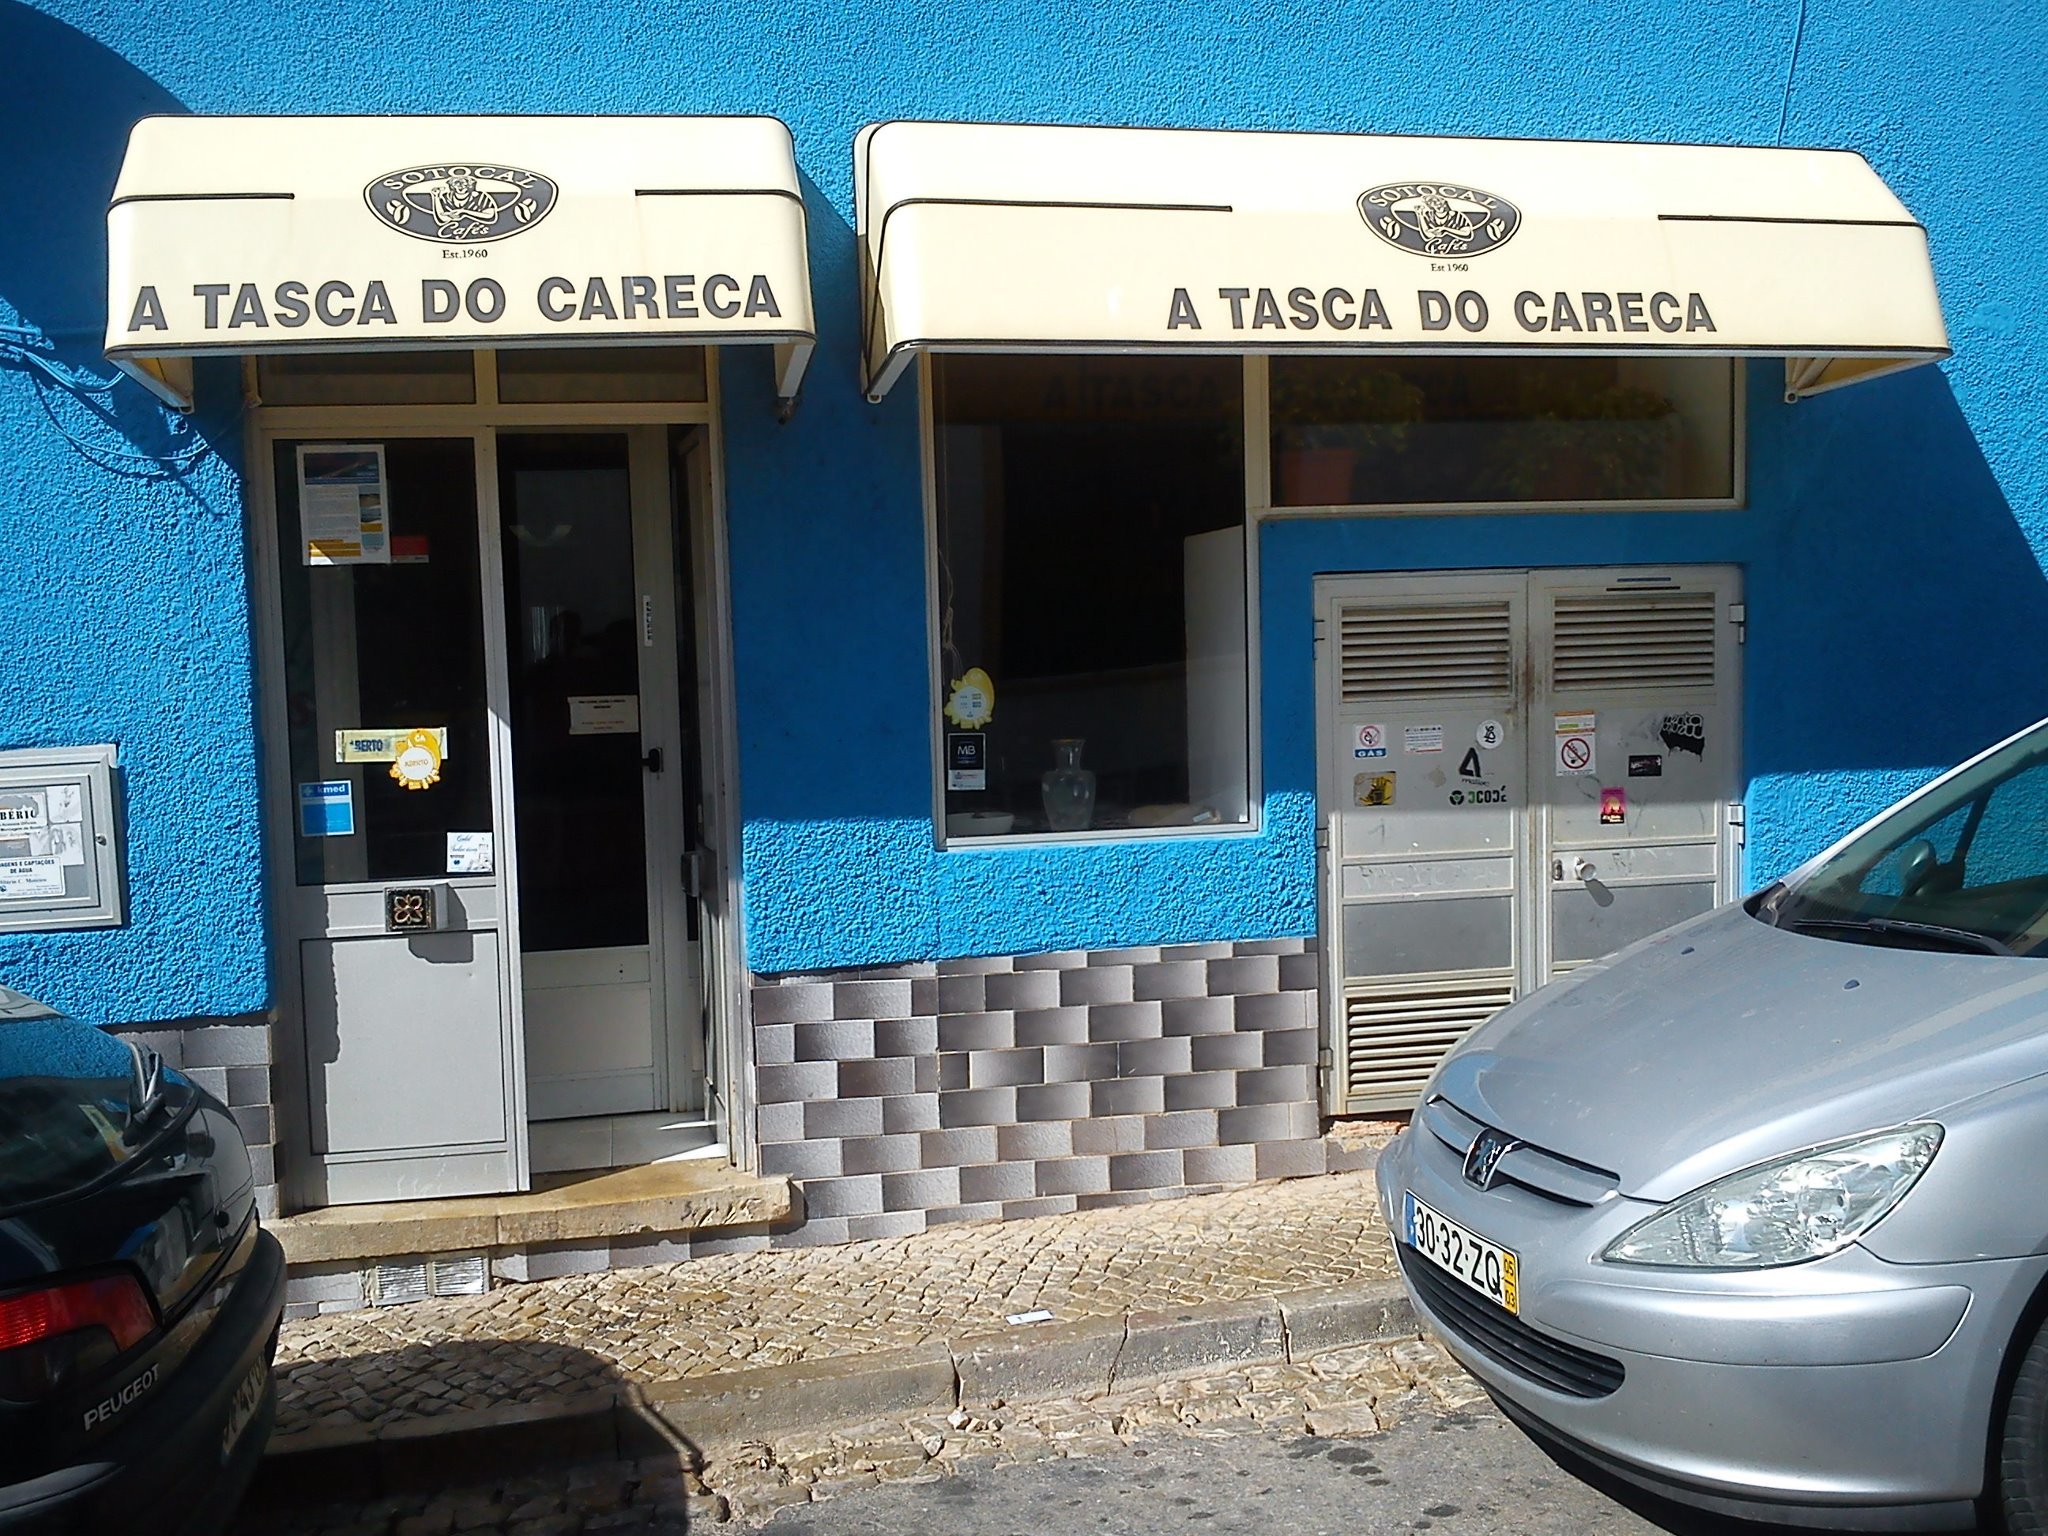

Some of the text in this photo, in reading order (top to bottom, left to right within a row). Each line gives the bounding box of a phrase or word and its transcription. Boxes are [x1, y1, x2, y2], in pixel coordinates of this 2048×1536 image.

[383, 166, 537, 190] SOTOCAL
[1369, 185, 1497, 209] SOTOCAL
[437, 221, 489, 239] Cafés
[127, 274, 782, 332] A TASCA DO CARECA
[1167, 287, 1718, 333] A TASCA DO CARECA
[957, 745, 976, 755] MB
[1357, 749, 1383, 757] GAS
[83, 1363, 160, 1432] PEUGEOT
